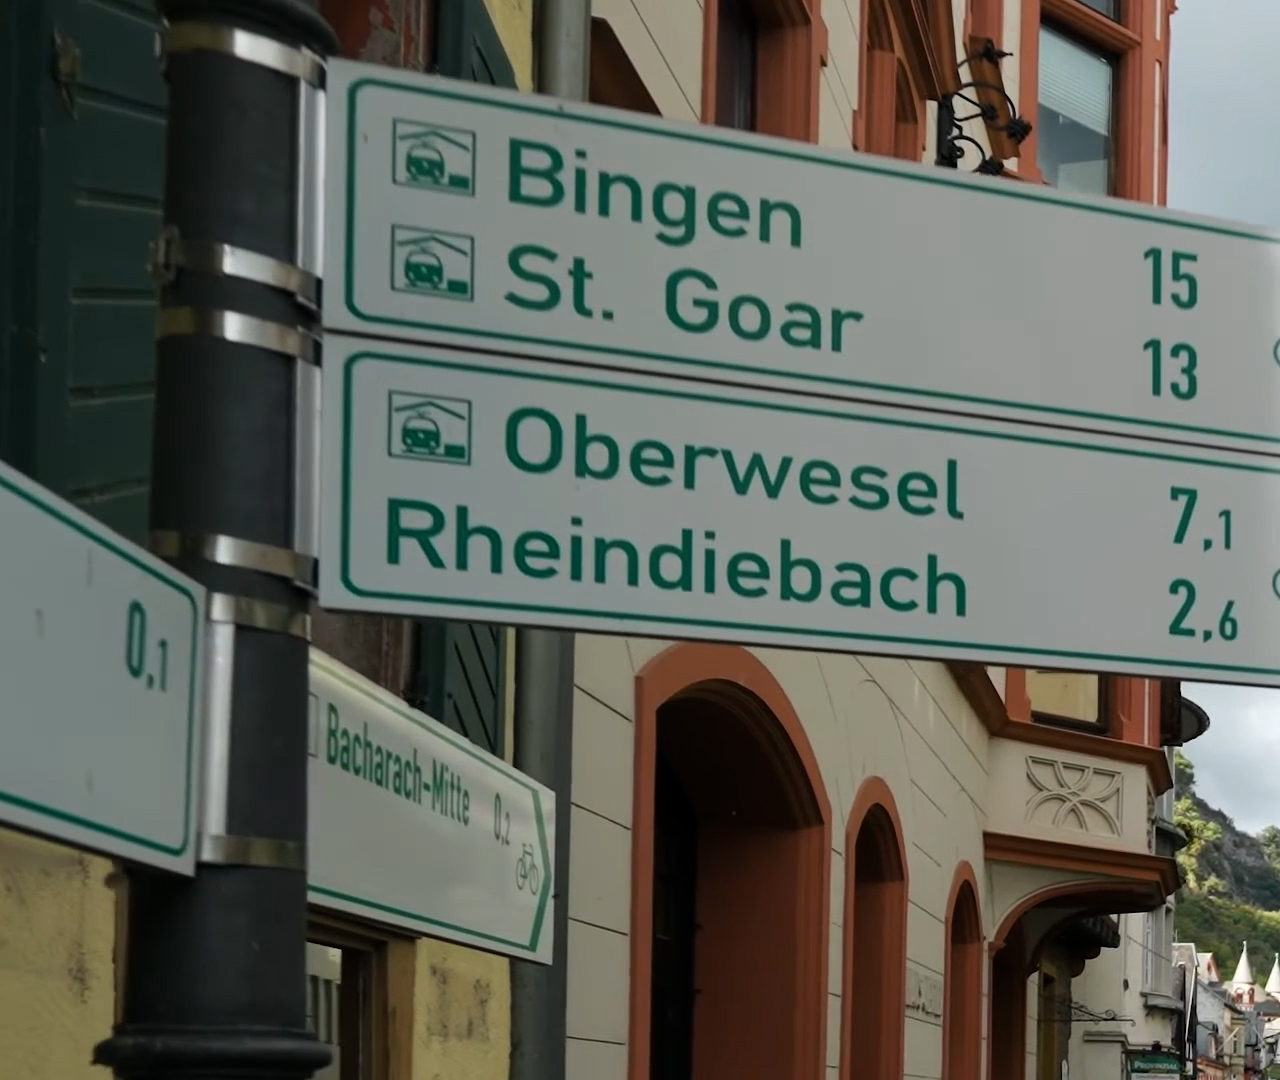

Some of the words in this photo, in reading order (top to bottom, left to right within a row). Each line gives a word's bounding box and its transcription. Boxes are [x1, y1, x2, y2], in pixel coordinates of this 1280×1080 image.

[508, 137, 803, 248] Bingen
[1143, 246, 1199, 311] 15
[504, 243, 615, 321] St.
[664, 267, 864, 353] Goar
[1143, 338, 1199, 401] 13
[505, 406, 965, 521] Oberwesel
[1169, 485, 1233, 552] 7,1
[387, 497, 968, 617] Rheindiebach
[1168, 578, 1239, 643] 2,6
[125, 599, 168, 693] 0,1
[326, 702, 471, 827] Bacharach-Mitte
[493, 792, 511, 846] 0,2
